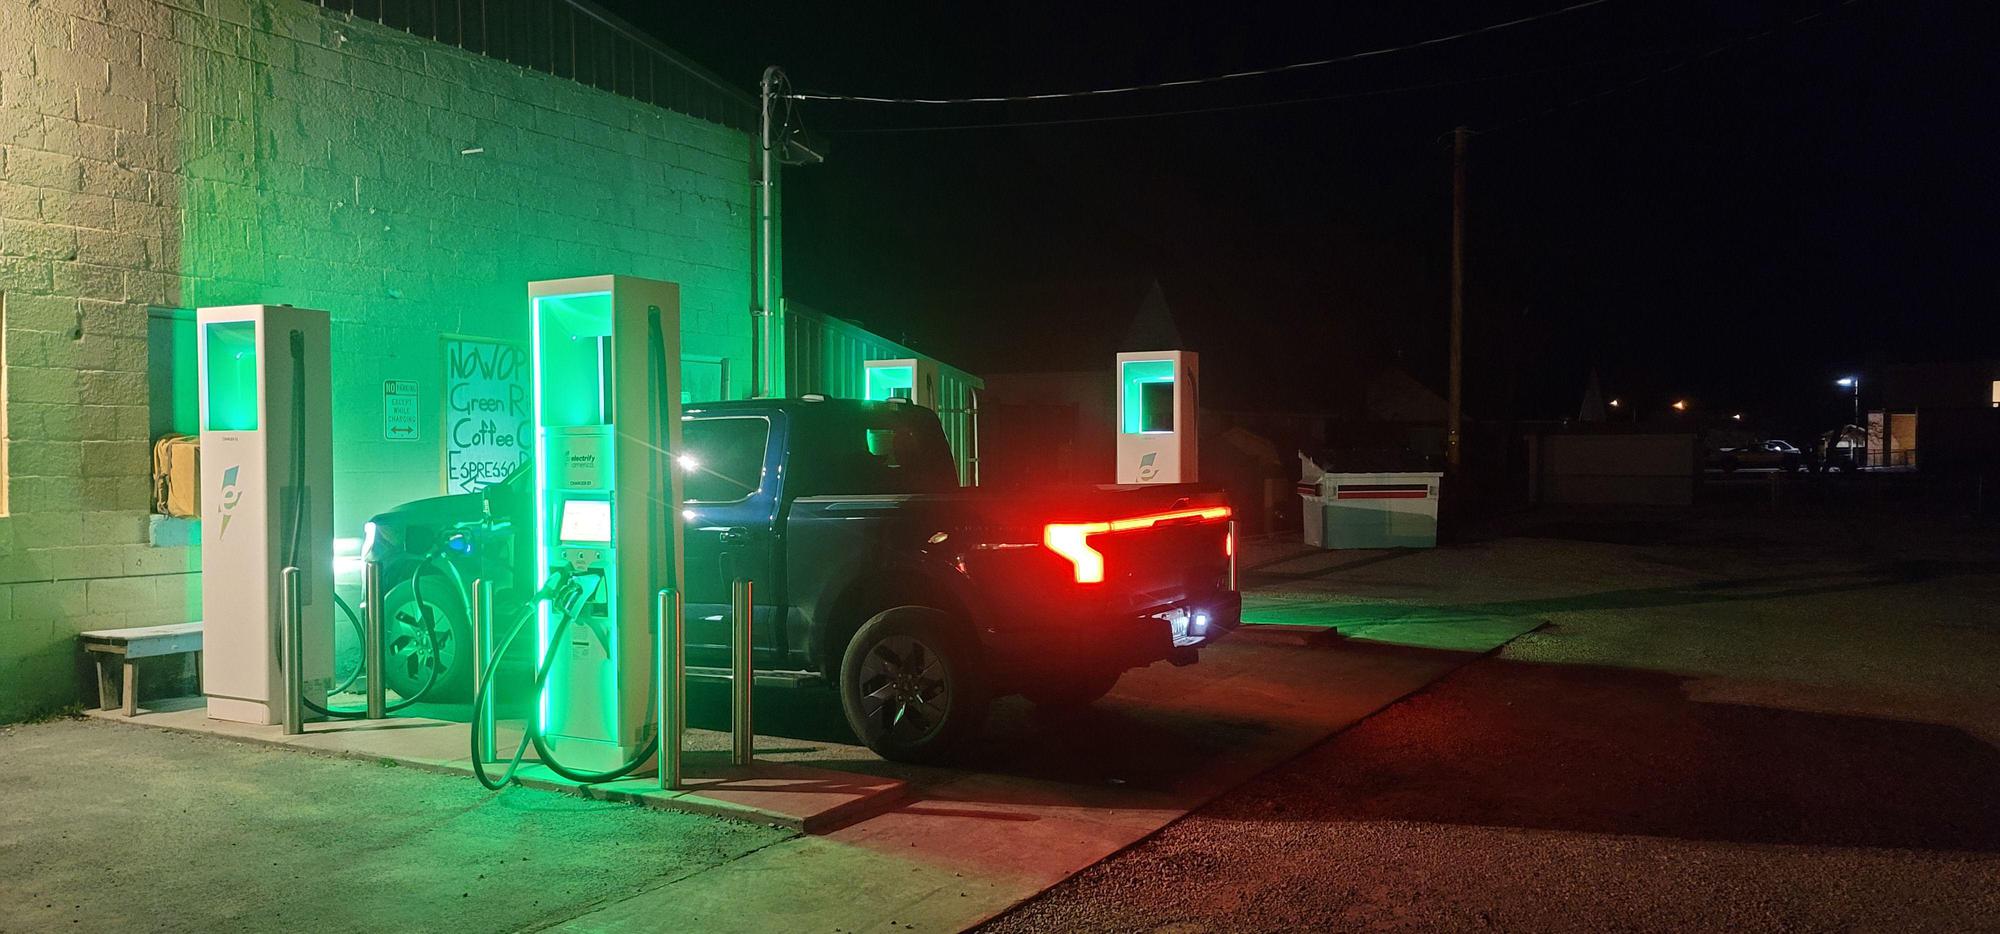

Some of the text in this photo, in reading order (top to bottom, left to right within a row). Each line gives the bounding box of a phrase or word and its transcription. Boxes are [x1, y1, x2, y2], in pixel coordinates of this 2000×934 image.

[386, 383, 396, 393] NO
[450, 382, 505, 415] Green
[453, 417, 514, 449] Coffee
[571, 454, 596, 463] electrify
